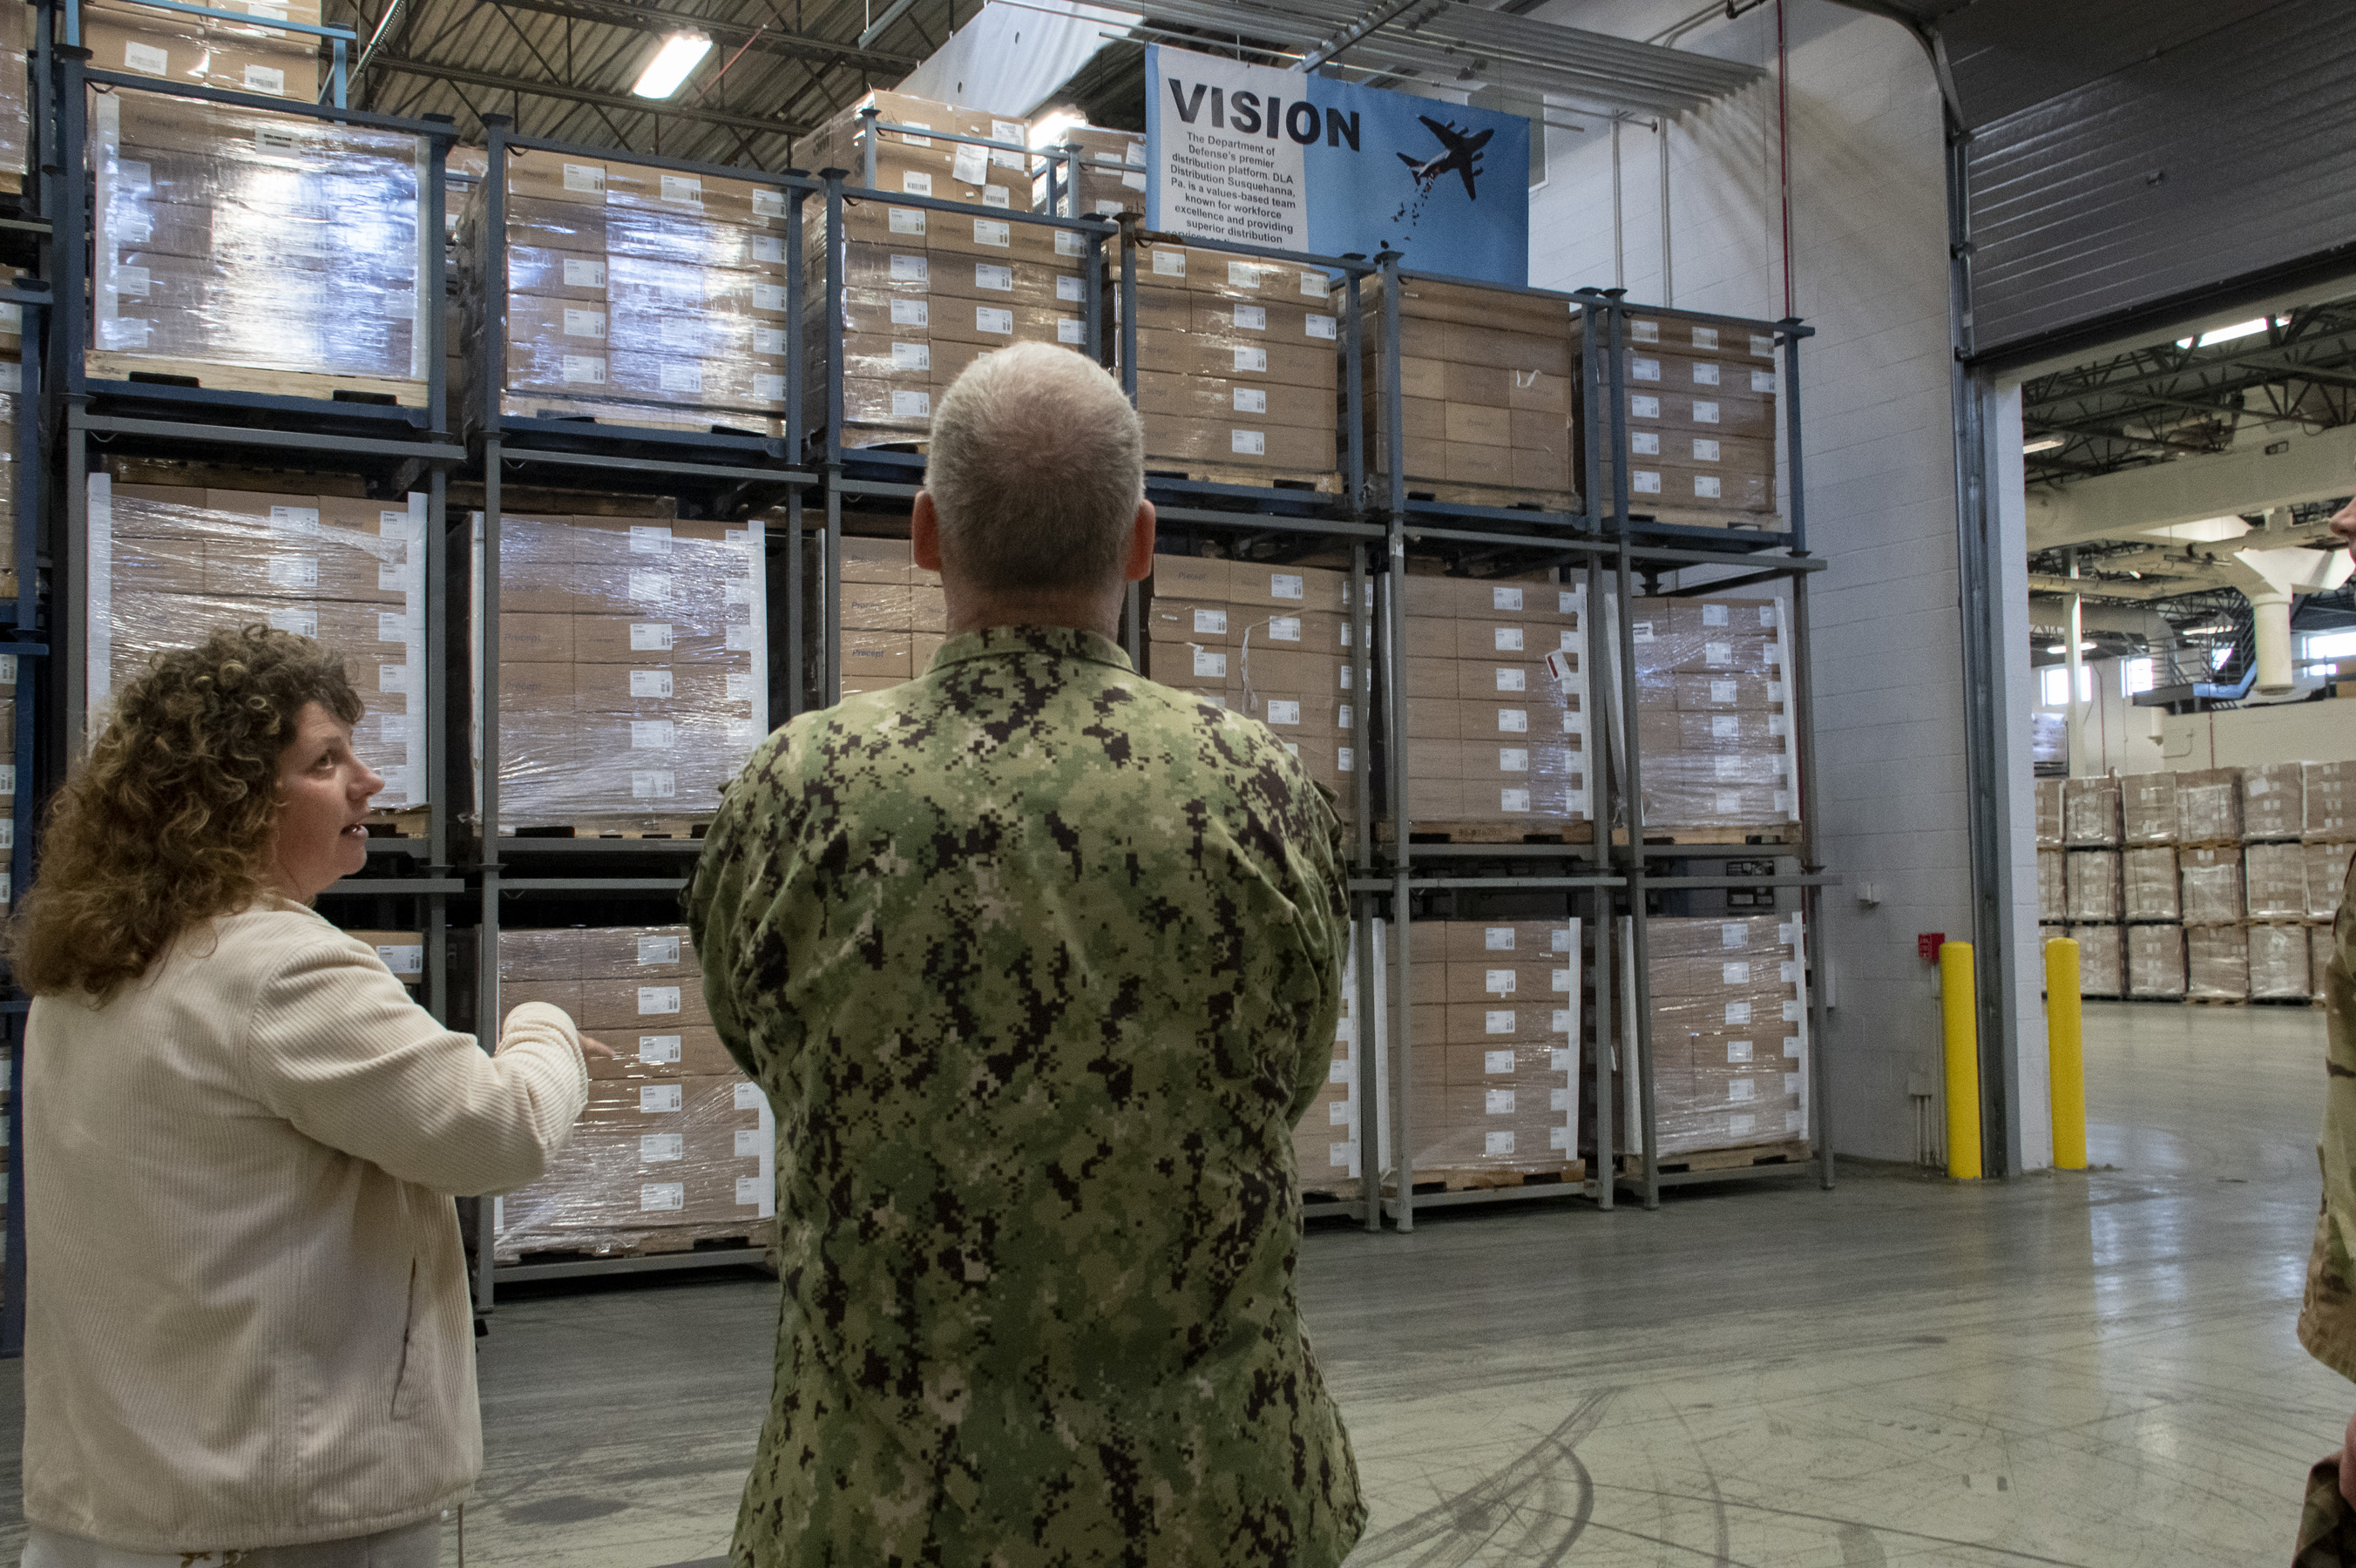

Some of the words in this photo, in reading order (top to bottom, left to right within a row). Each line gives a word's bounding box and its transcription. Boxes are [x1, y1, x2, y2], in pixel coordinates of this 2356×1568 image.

[1168, 78, 1361, 152] VISION
[1187, 132, 1204, 144] The
[1208, 136, 1264, 154] Department
[1266, 147, 1276, 157] of
[1188, 145, 1236, 161] Defense's
[1239, 154, 1275, 169] premier
[1170, 164, 1225, 185] Distribution
[1228, 177, 1296, 198] Susquehanna,
[1172, 152, 1226, 172] distribution
[1228, 164, 1270, 180] platform.
[1273, 172, 1294, 184] DLA
[1171, 177, 1186, 189] Pa.
[1188, 181, 1196, 191] is
[1206, 187, 1269, 206] values-based
[1271, 197, 1296, 209] team
[1185, 193, 1215, 208] known
[1218, 199, 1231, 211] for
[1234, 204, 1282, 220] workforce
[1175, 205, 1224, 221] excellence
[1227, 214, 1244, 226] and
[1247, 219, 1294, 234] providing
[1186, 220, 1225, 235] superior
[1228, 224, 1283, 244] distribution
